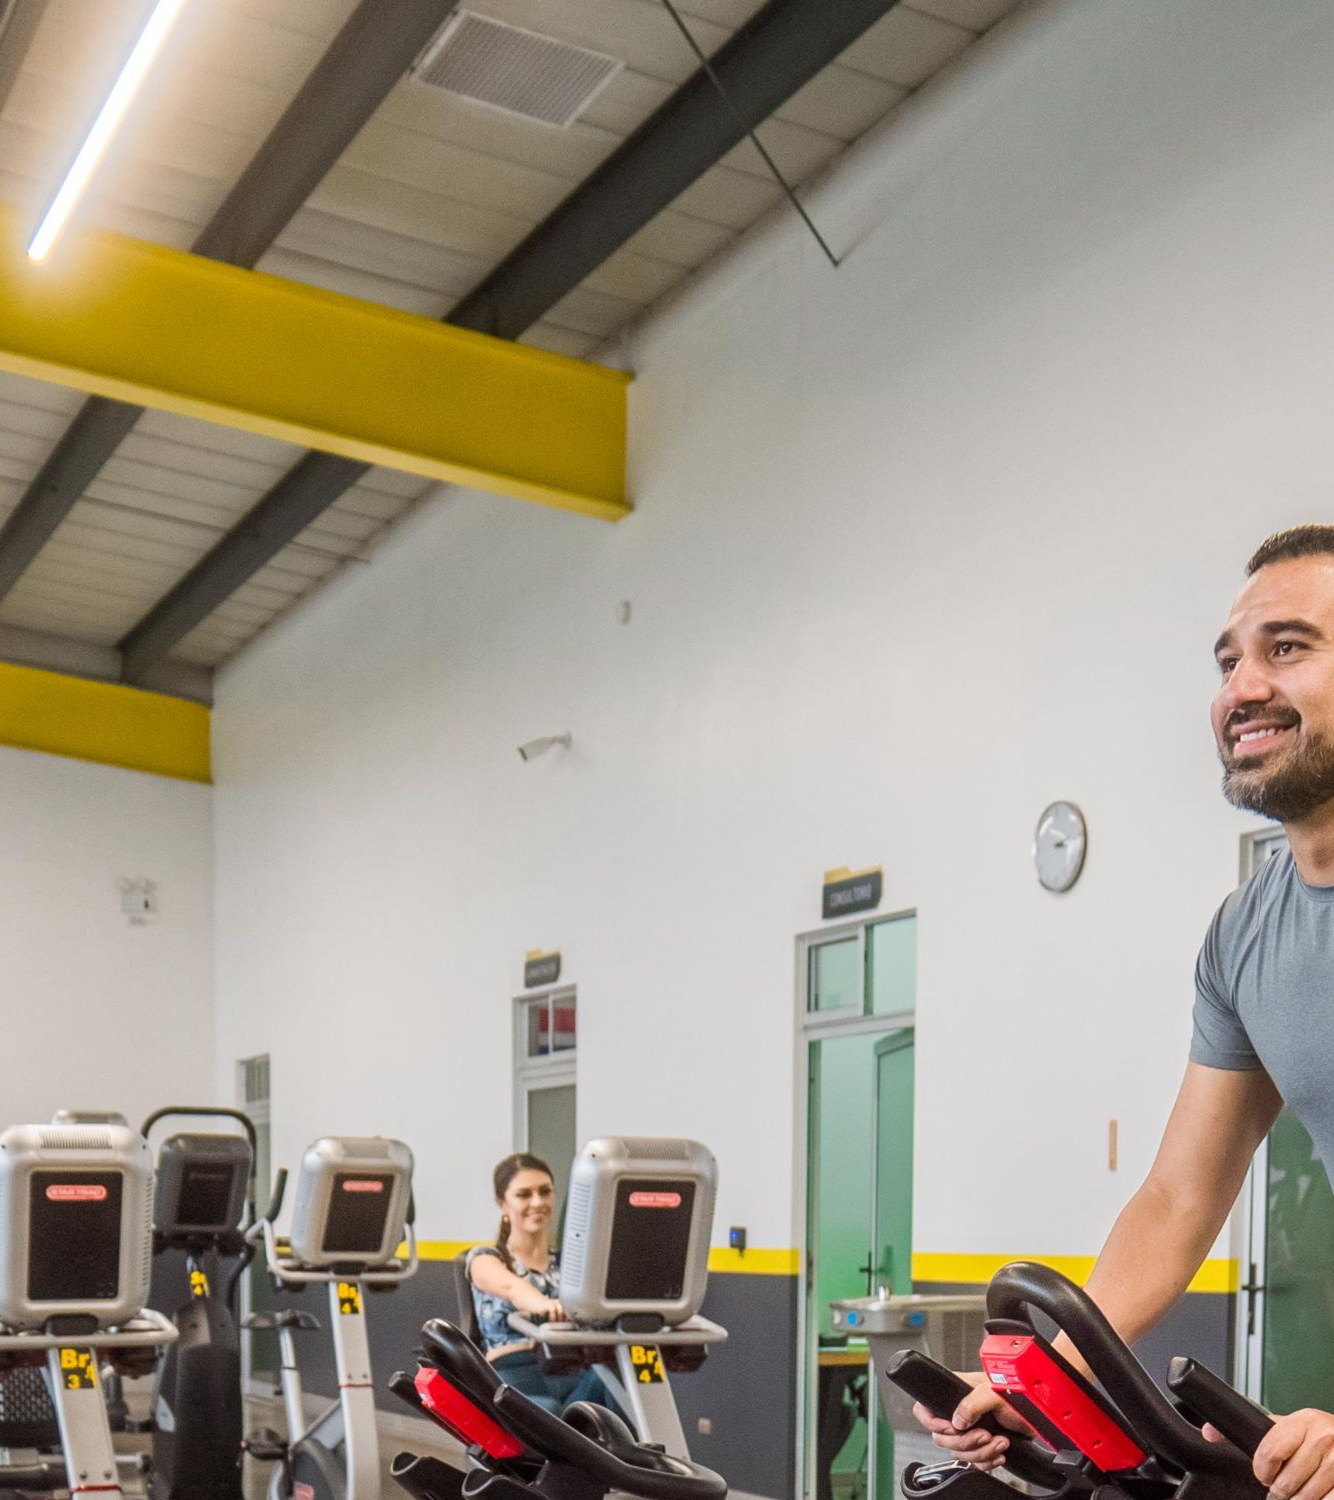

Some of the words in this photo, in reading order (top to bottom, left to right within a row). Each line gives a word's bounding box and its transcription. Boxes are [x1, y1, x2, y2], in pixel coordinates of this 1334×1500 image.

[60, 1348, 90, 1368] Br
[630, 1345, 657, 1365] Br
[67, 1374, 79, 1389] 3
[639, 1369, 651, 1384] 4
